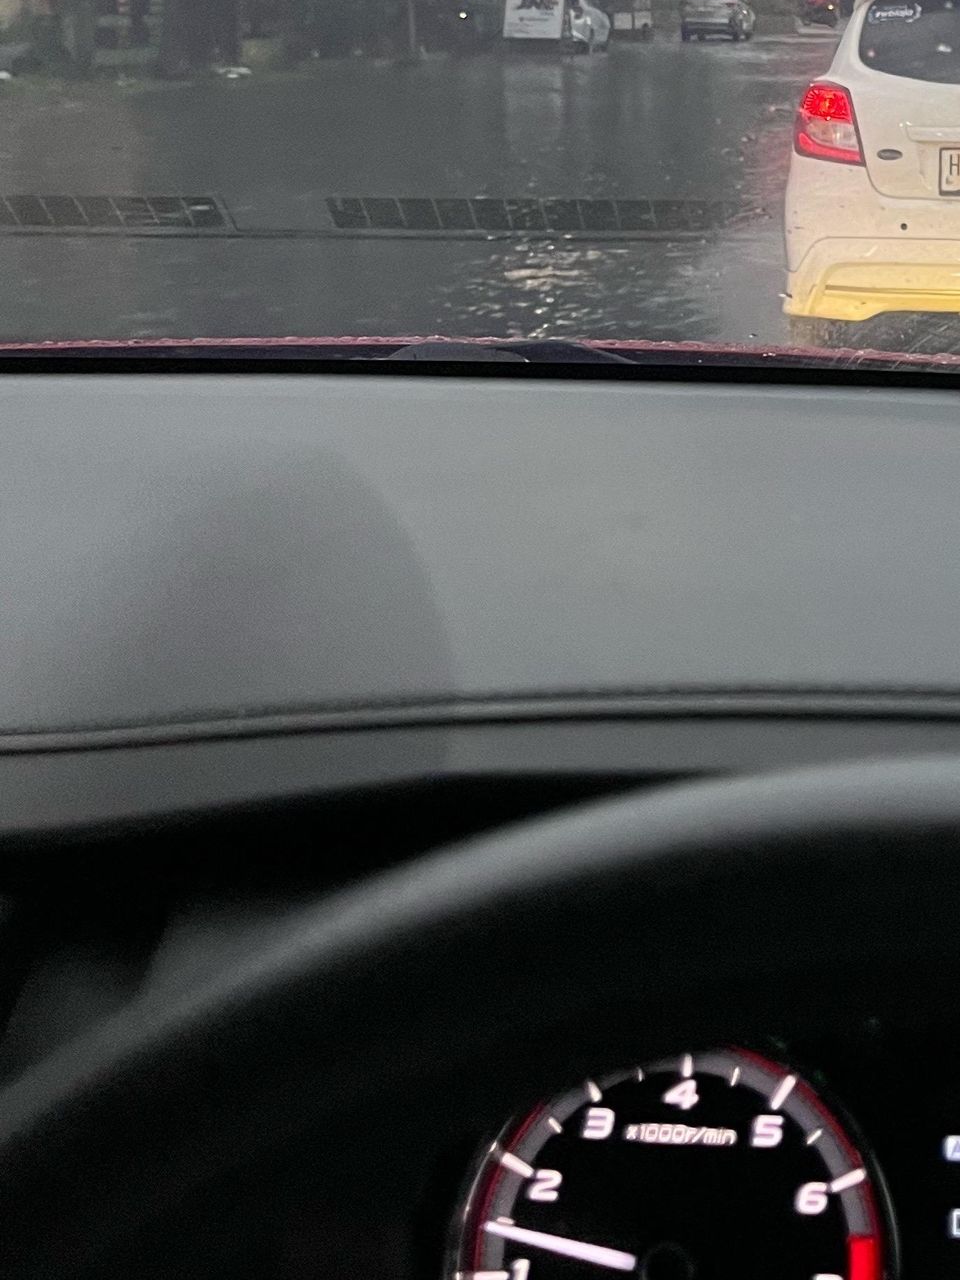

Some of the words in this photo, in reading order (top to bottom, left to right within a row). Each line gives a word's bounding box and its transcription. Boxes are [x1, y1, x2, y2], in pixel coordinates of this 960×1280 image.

[949, 153, 960, 176] H
[663, 1079, 699, 1110] 4
[583, 1108, 615, 1139] 3
[624, 1123, 737, 1145] x1000r/min
[752, 1115, 783, 1148] 5
[529, 1170, 562, 1201] 2
[796, 1181, 829, 1215] 6
